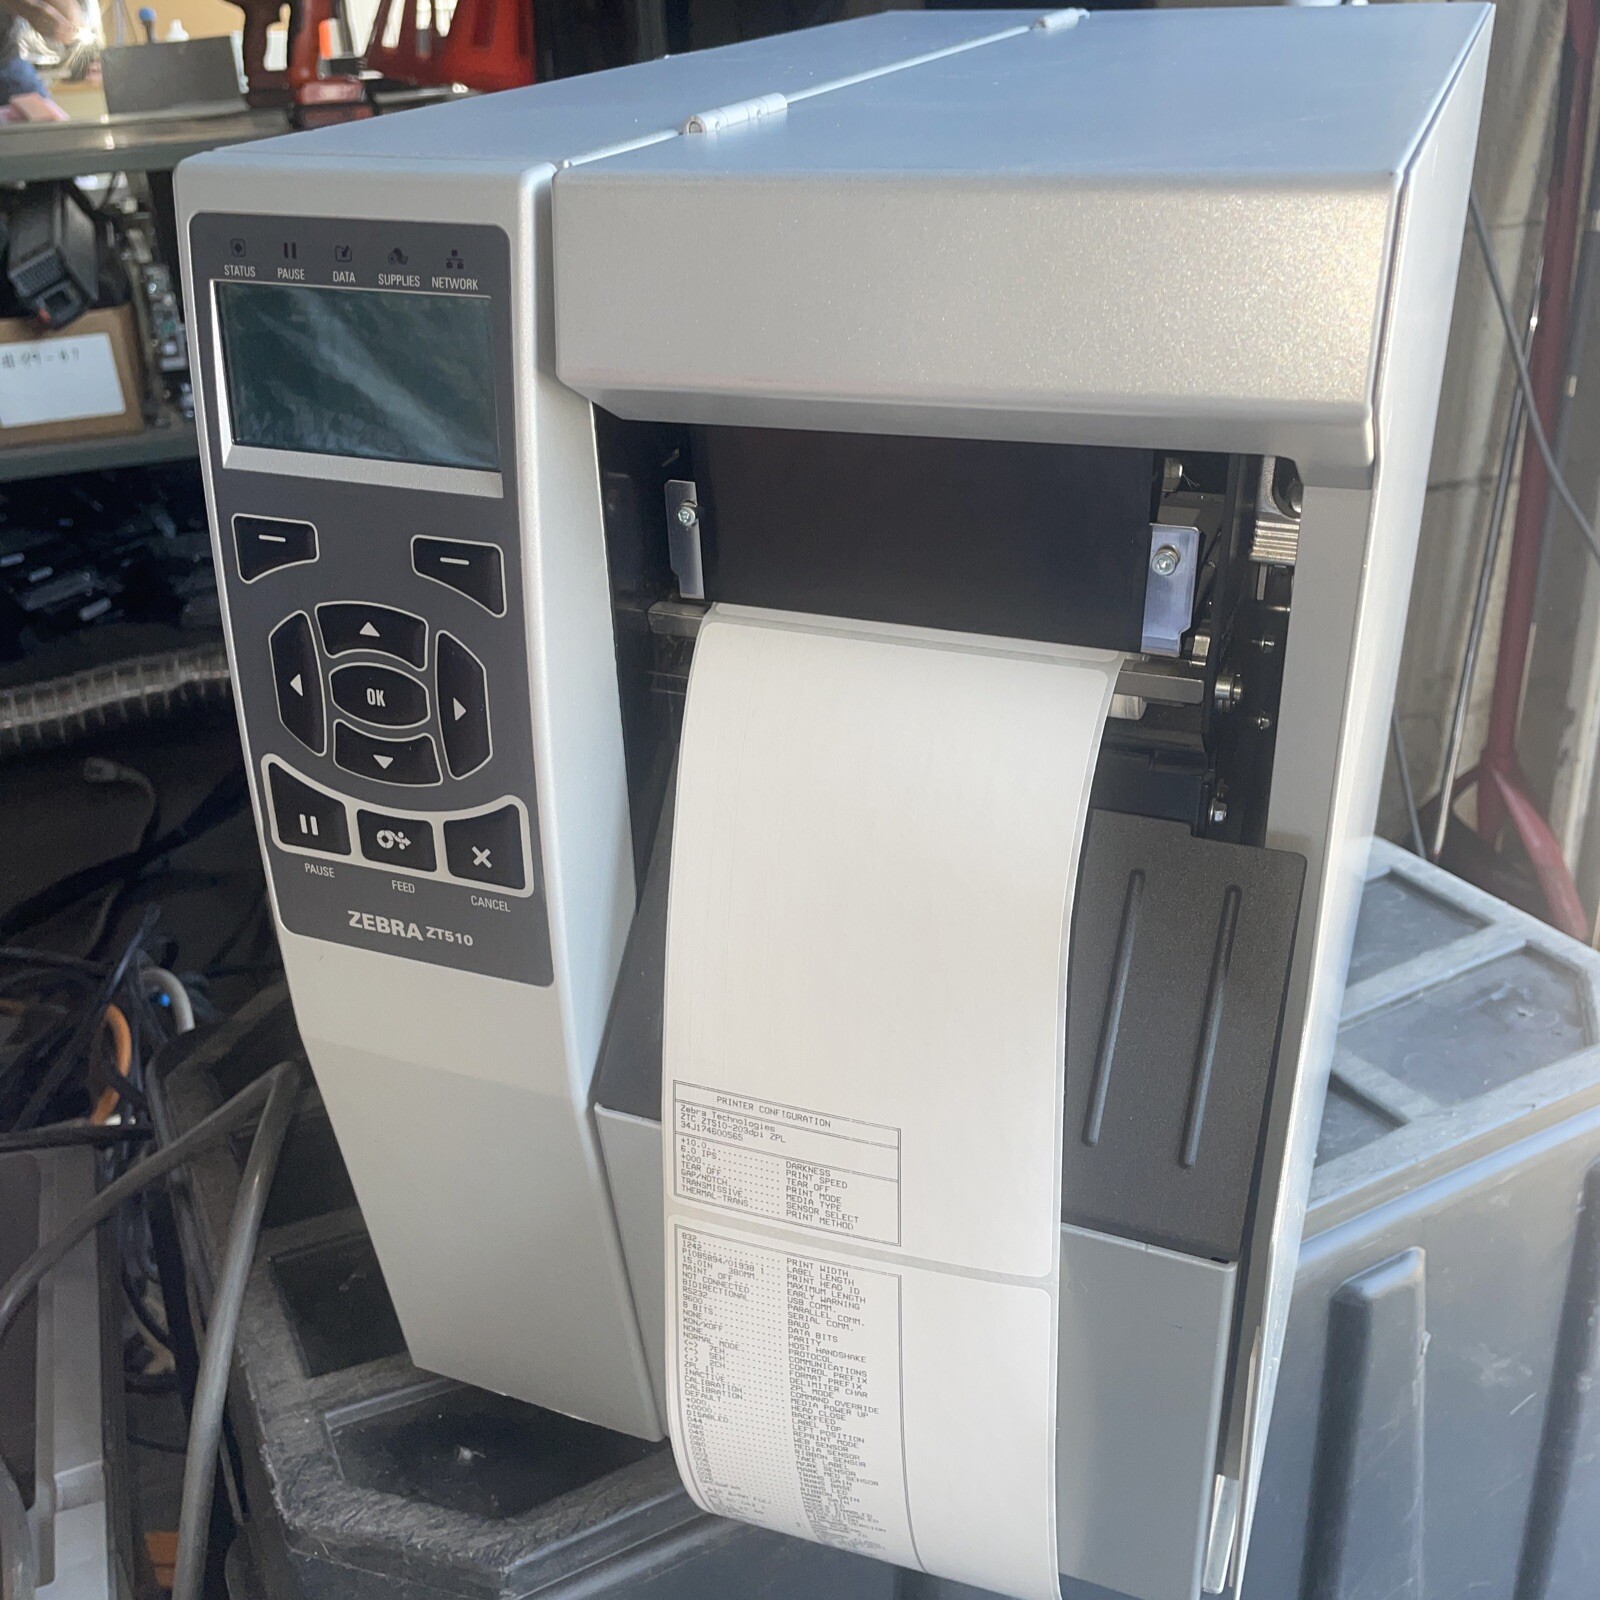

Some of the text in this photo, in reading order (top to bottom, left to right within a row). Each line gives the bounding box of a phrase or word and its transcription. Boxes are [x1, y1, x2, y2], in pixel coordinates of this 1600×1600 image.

[224, 265, 256, 277] STATUS
[277, 268, 304, 280] PAUSE
[333, 271, 355, 283] DATA
[378, 273, 420, 287] SUPPLIES
[432, 277, 478, 290] NETWORK
[367, 688, 385, 706] OK
[304, 863, 335, 878] PAUSE
[392, 880, 415, 894] FEED
[471, 895, 511, 912] CANCEL
[348, 910, 473, 946] ZEBRA ZT510
[680, 1105, 775, 1132] Zebra Technologies
[716, 1096, 831, 1128] PRINTER CONFIGURATION
[681, 1113, 785, 1144] ZTC ZT510-203dpi ZPL
[681, 1121, 743, 1141] 34J174600565
[702, 1150, 716, 1159] IPS
[786, 1170, 813, 1181] PRINT
[820, 1177, 847, 1189] SPEED
[786, 1161, 830, 1177] DARKNESS
[681, 1169, 841, 1212] GAP/NOTCH MEDIA TYPE
[682, 1161, 841, 1204] TEAR OFF PRINT MODE
[787, 1178, 808, 1188] TEAR
[814, 1184, 830, 1192] OFF
[682, 1177, 859, 1223] TRANSMISSIVE SENSOR SELECT
[682, 1185, 853, 1230] THERMAL-TRANS PRINT METHOD
[682, 1233, 848, 1277] 832 PRINT WIDTH
[787, 1266, 814, 1277] LABEL
[820, 1274, 854, 1286] LENGTH
[787, 1274, 814, 1285] PRINT
[820, 1281, 842, 1291] HEAD
[682, 1272, 697, 1280] NOT
[703, 1277, 750, 1293] CONNECTED
[788, 1297, 804, 1305] USB
[682, 1278, 749, 1301] BIDIRECTIONAL
[788, 1304, 832, 1319] PARALLEL
[718, 1273, 732, 1281] OFF
[787, 1289, 814, 1300] EARLY
[820, 1297, 860, 1310] WARNING
[787, 1282, 826, 1295] MAXIMUM
[832, 1291, 866, 1303] LENGTH
[683, 1286, 708, 1299] RS232
[788, 1312, 820, 1324] SERIAL
[683, 1309, 821, 1346] NONE PARITY
[788, 1320, 810, 1329] BAUD
[788, 1327, 810, 1337] DATA
[816, 1333, 838, 1342] BITS
[683, 1324, 832, 1363] NONE PROTOCOL
[789, 1342, 810, 1351] HOST
[816, 1347, 866, 1363] HANDSHAKE
[683, 1332, 867, 1377] NORMAL MODE COMMUNICATIONS
[789, 1363, 828, 1376] CONTROL
[834, 1372, 867, 1384] PREFIX
[790, 1370, 821, 1382] FORMAT
[828, 1378, 862, 1390] PREFIX
[790, 1377, 840, 1392] DELIMITER
[812, 1389, 834, 1398] MODE
[790, 1391, 829, 1404] COMMAND
[835, 1400, 879, 1414] OVERRIDE
[791, 1398, 818, 1409] MEDIA
[824, 1405, 851, 1415] POWER
[791, 1405, 813, 1414] HEAD
[819, 1410, 846, 1421] CLOSE
[792, 1412, 836, 1425] BACKFEED
